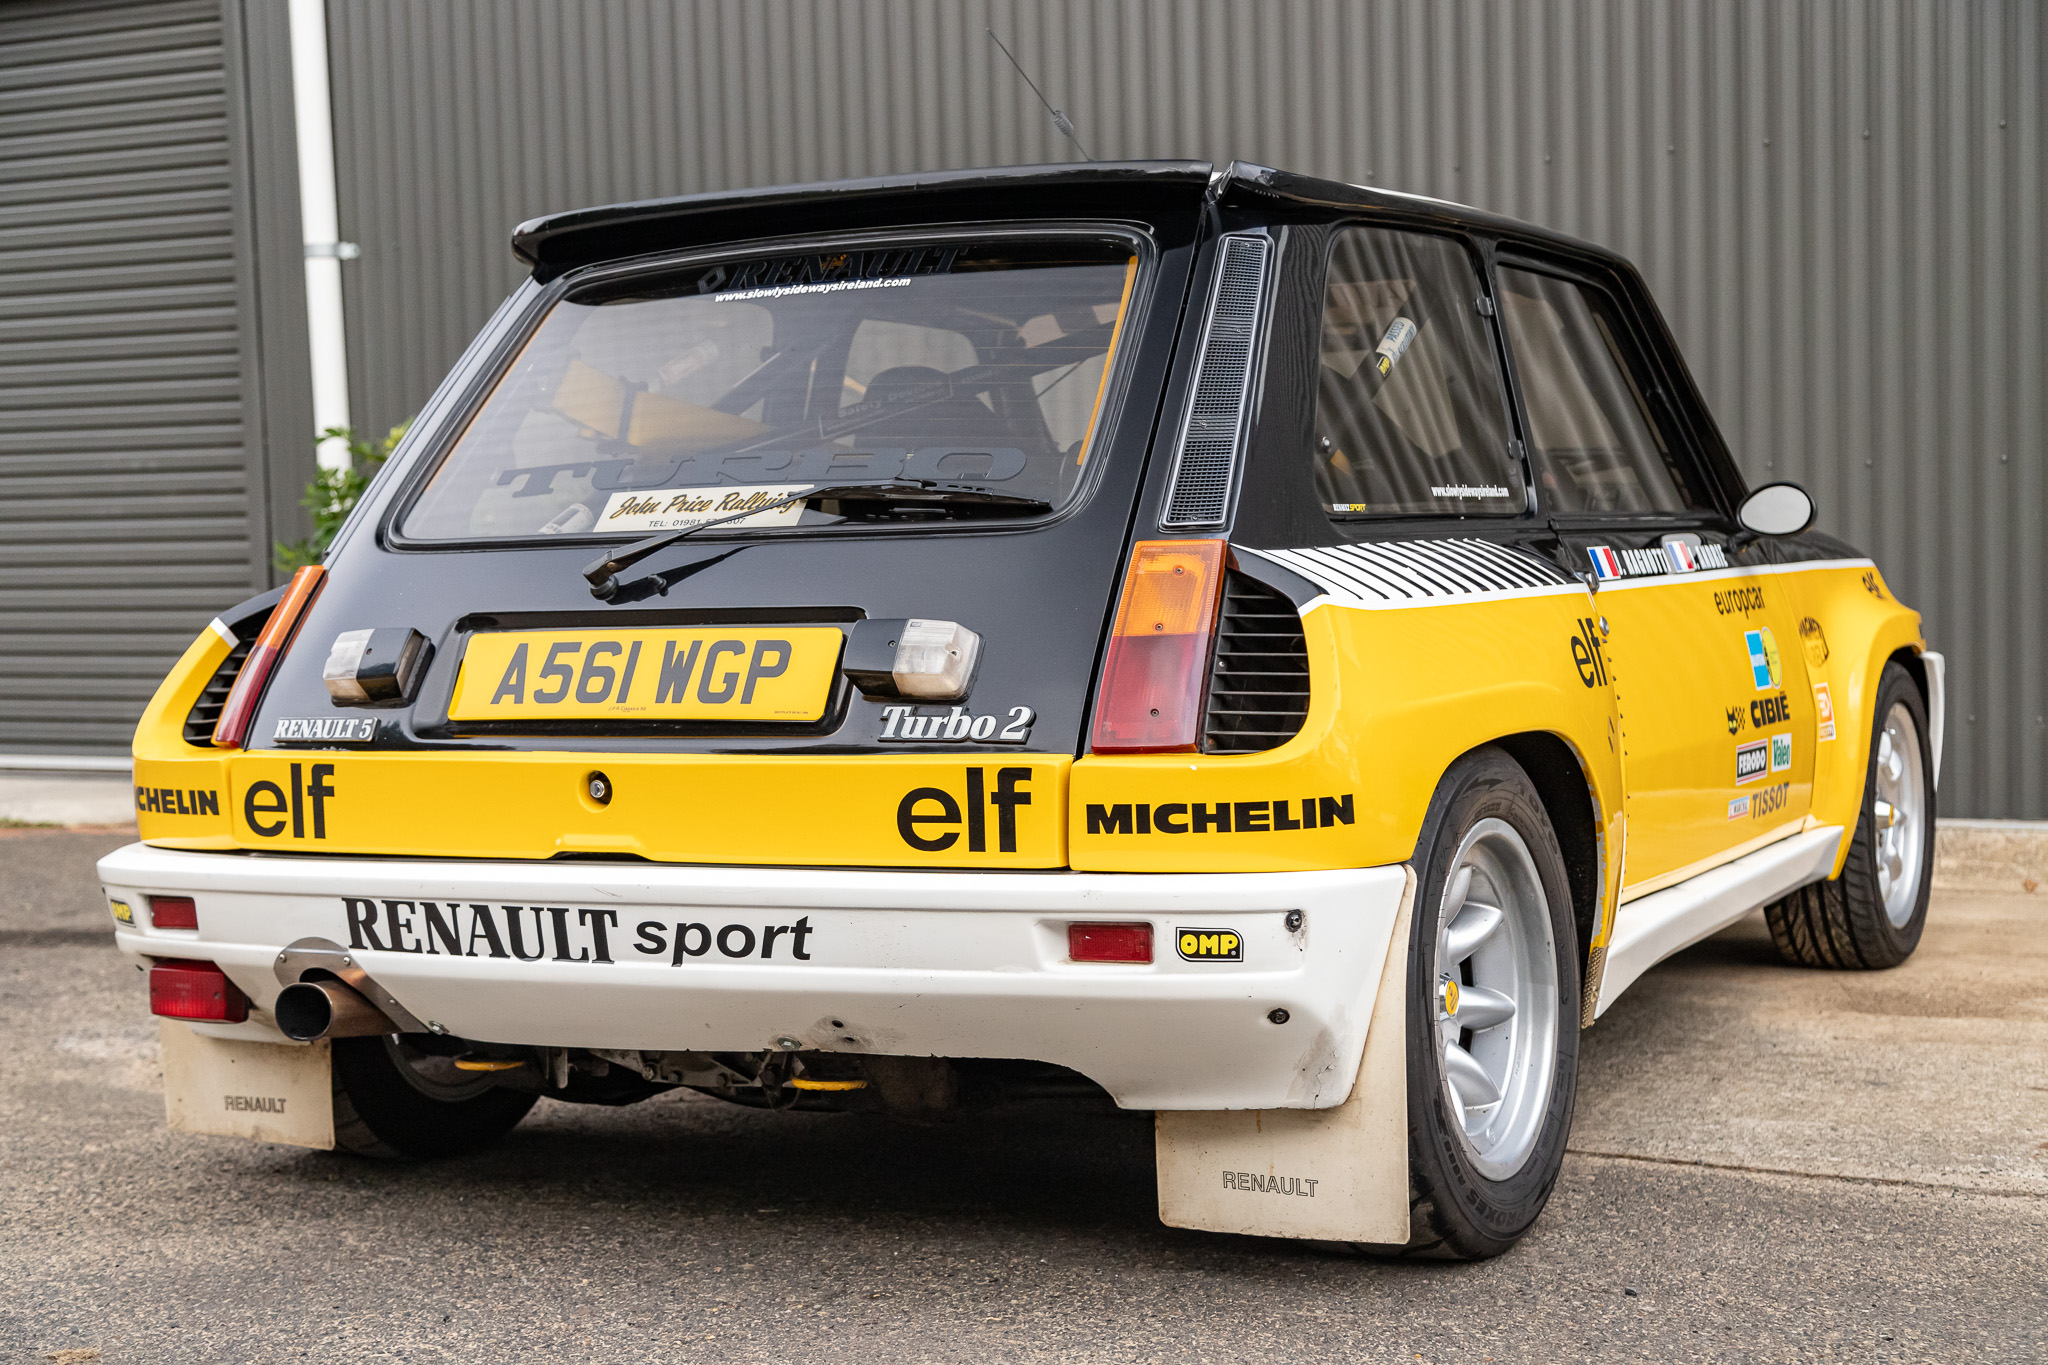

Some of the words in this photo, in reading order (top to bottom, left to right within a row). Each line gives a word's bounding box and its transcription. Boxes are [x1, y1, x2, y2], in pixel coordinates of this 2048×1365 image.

[724, 246, 970, 291] RENAULT
[714, 277, 911, 303] www.slowlysidewaysireland.com
[496, 447, 1028, 498] TURBO
[610, 496, 661, 519] John
[662, 493, 713, 514] Price
[649, 519, 667, 528] TEL:
[1714, 586, 1766, 619] europcar
[1571, 618, 1608, 689] elf
[490, 640, 643, 704] A561
[655, 640, 793, 704] WGP
[273, 718, 359, 739] RENAULT
[359, 718, 373, 739] 5
[879, 706, 999, 740] Turbo
[999, 706, 1033, 739] 2
[1738, 748, 1766, 775] FERODO
[1773, 738, 1791, 767] Valeo
[135, 785, 220, 815] CHELIN
[244, 763, 335, 839] elf
[896, 767, 1032, 853] elf
[1086, 794, 1355, 834] MICHELIN
[1752, 782, 1790, 819] TISSOT
[342, 897, 618, 964] RENAULT
[633, 916, 812, 967] sport
[1180, 932, 1238, 956] OMP
[224, 1094, 286, 1113] RENAULT
[1222, 1171, 1319, 1198] RENAULT
